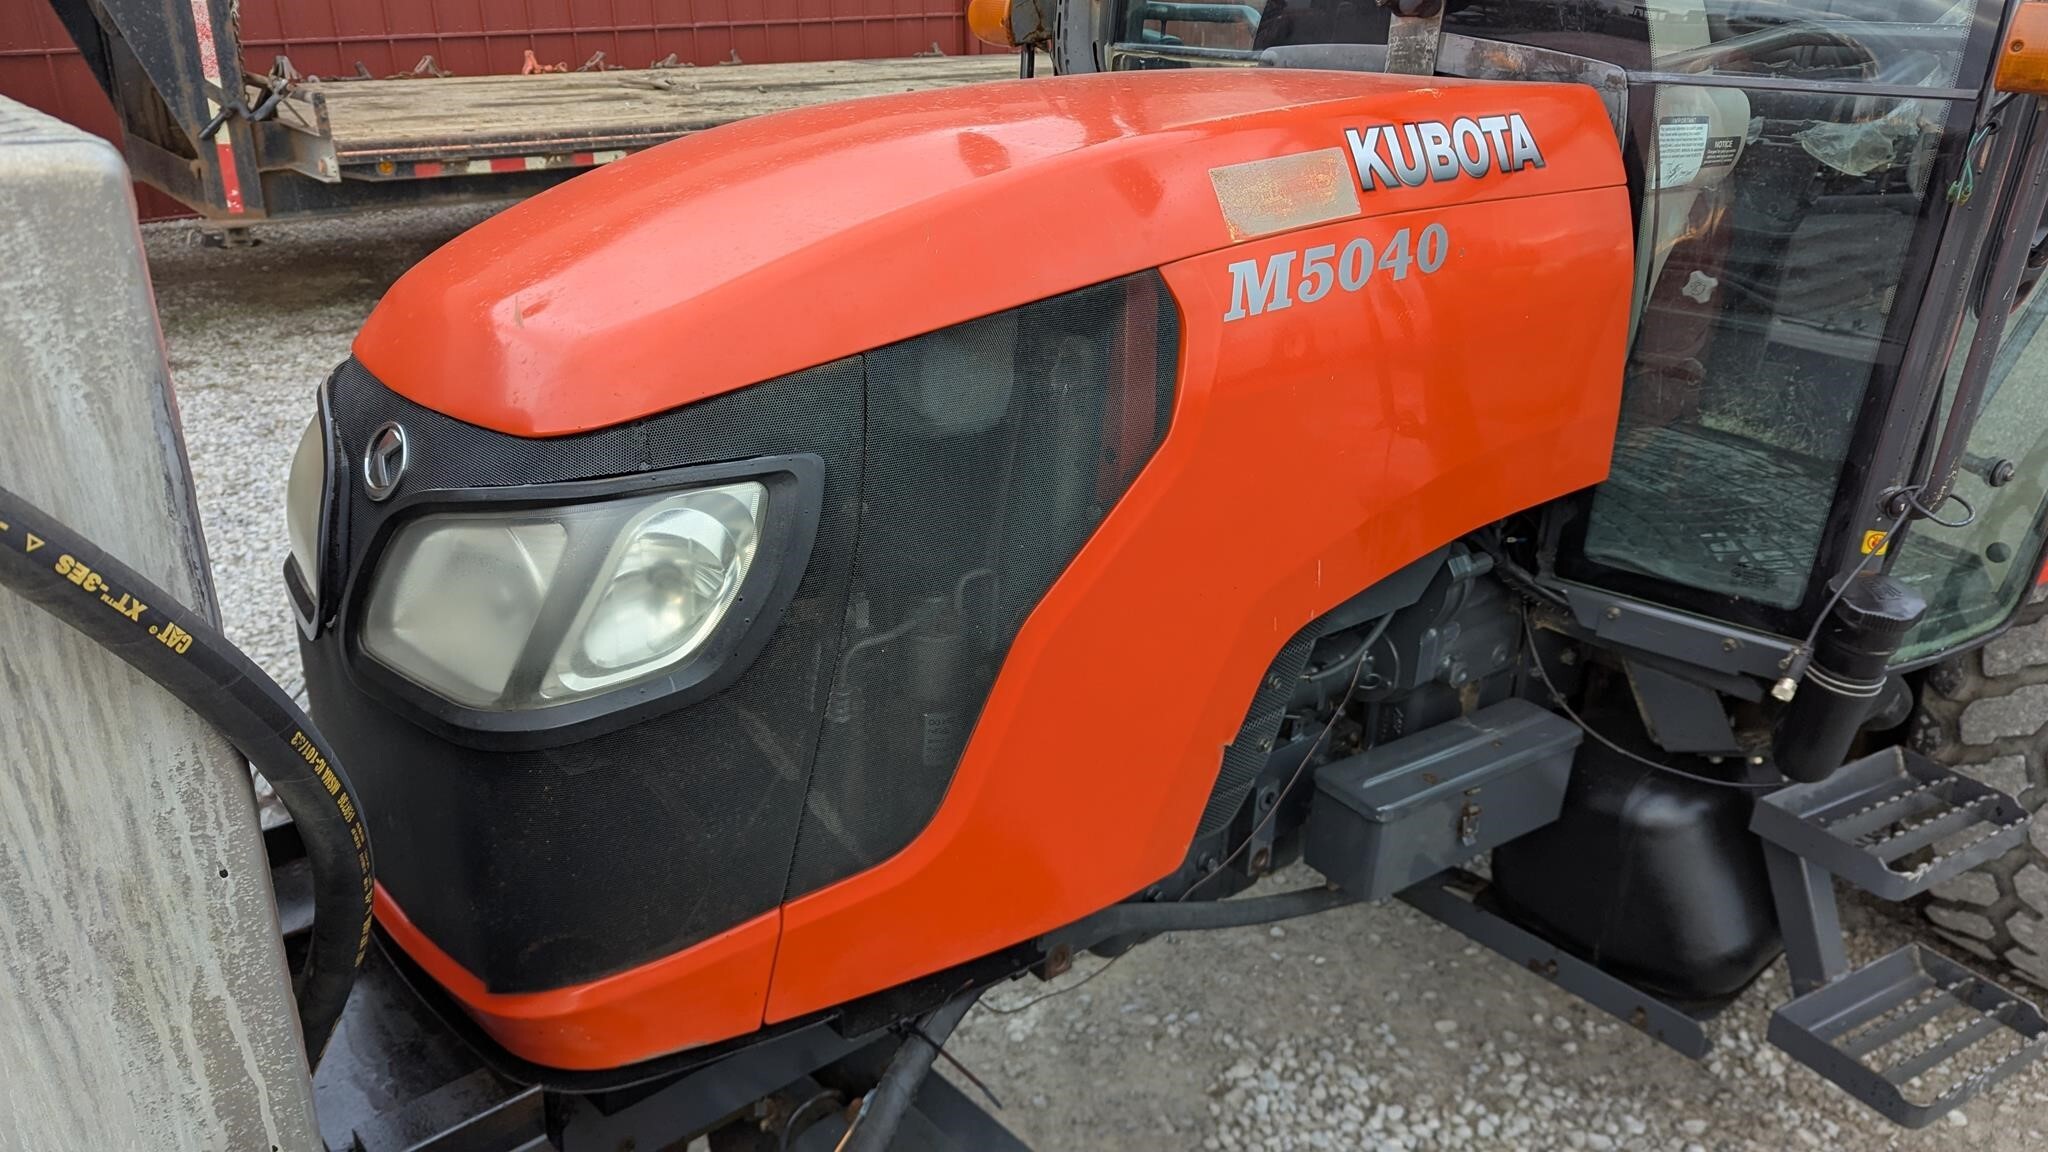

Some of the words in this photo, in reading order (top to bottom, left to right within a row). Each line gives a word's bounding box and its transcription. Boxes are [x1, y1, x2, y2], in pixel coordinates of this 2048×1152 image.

[1344, 112, 1546, 191] KUBOTA
[1714, 140, 1734, 149] NOTICE
[1223, 222, 1450, 323] M5040
